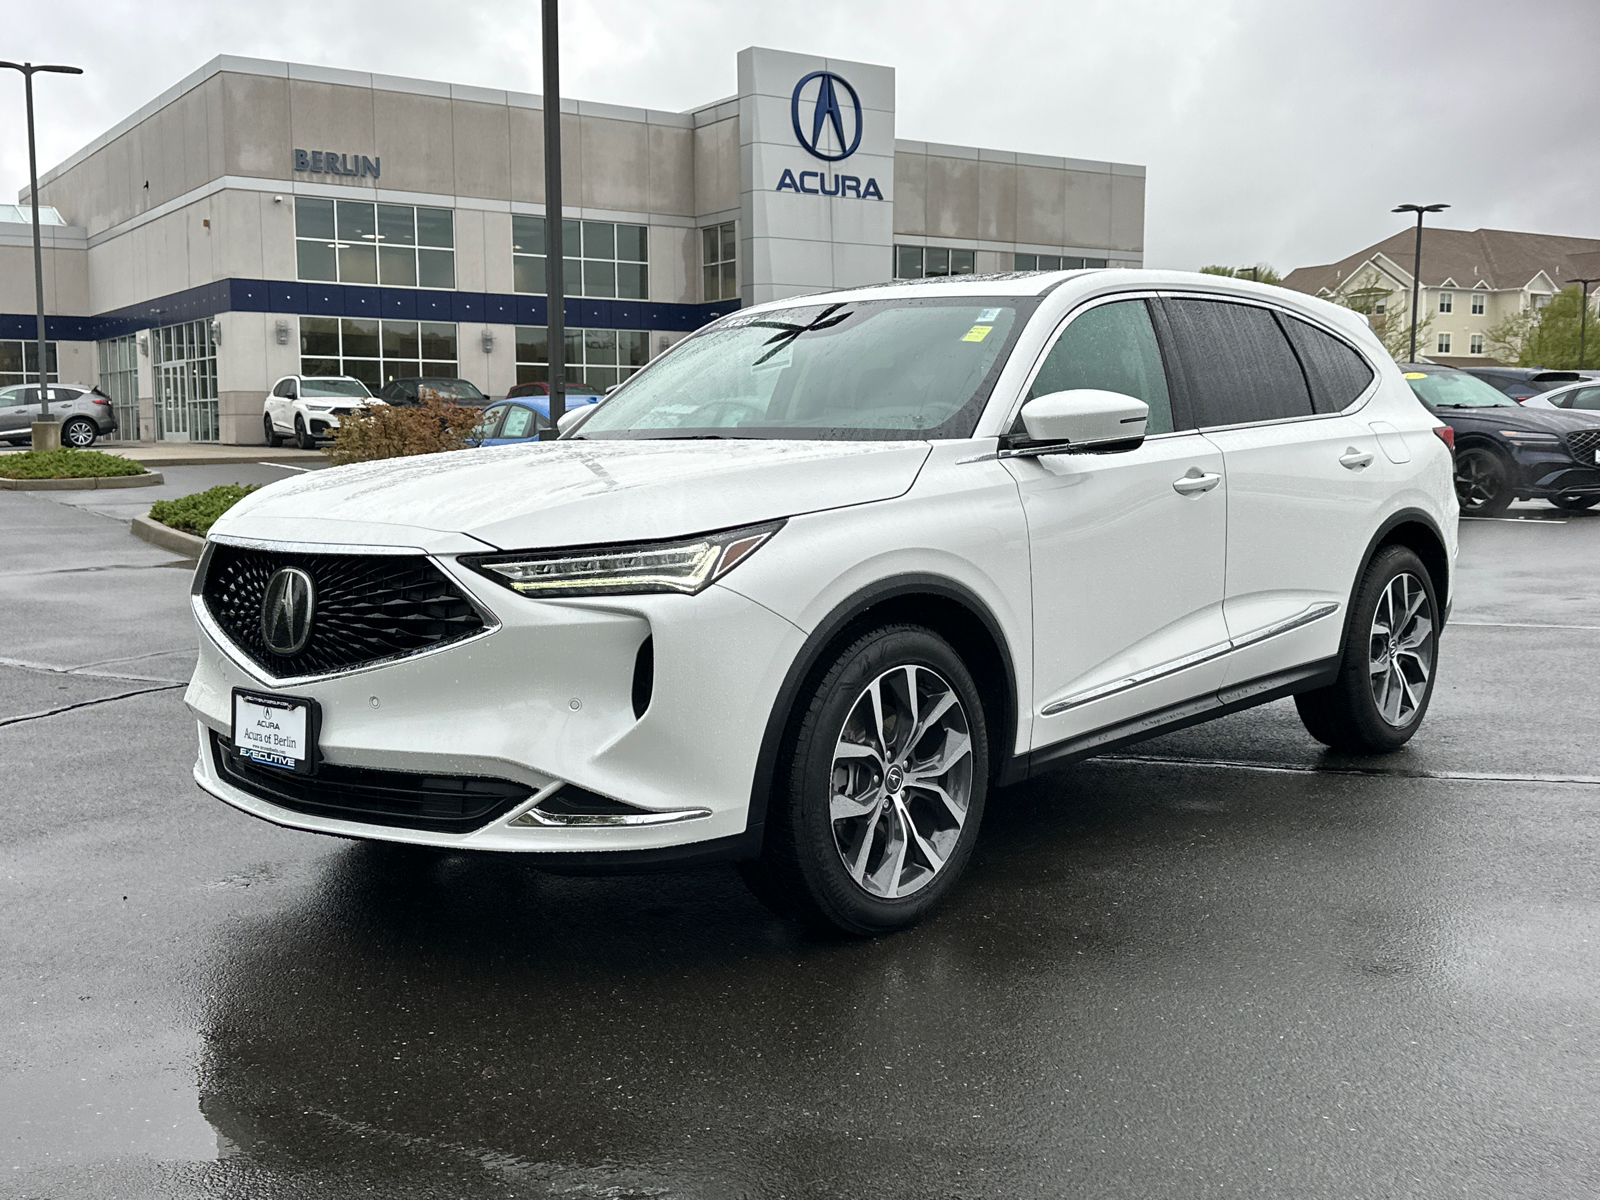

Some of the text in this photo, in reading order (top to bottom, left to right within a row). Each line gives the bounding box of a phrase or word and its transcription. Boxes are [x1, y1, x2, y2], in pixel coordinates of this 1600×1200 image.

[294, 149, 380, 178] BERLIN
[776, 168, 884, 201] ACURA
[257, 719, 281, 731] ACURA
[244, 727, 297, 748] Acura of Berlin
[239, 747, 296, 767] EXECUTIVE
